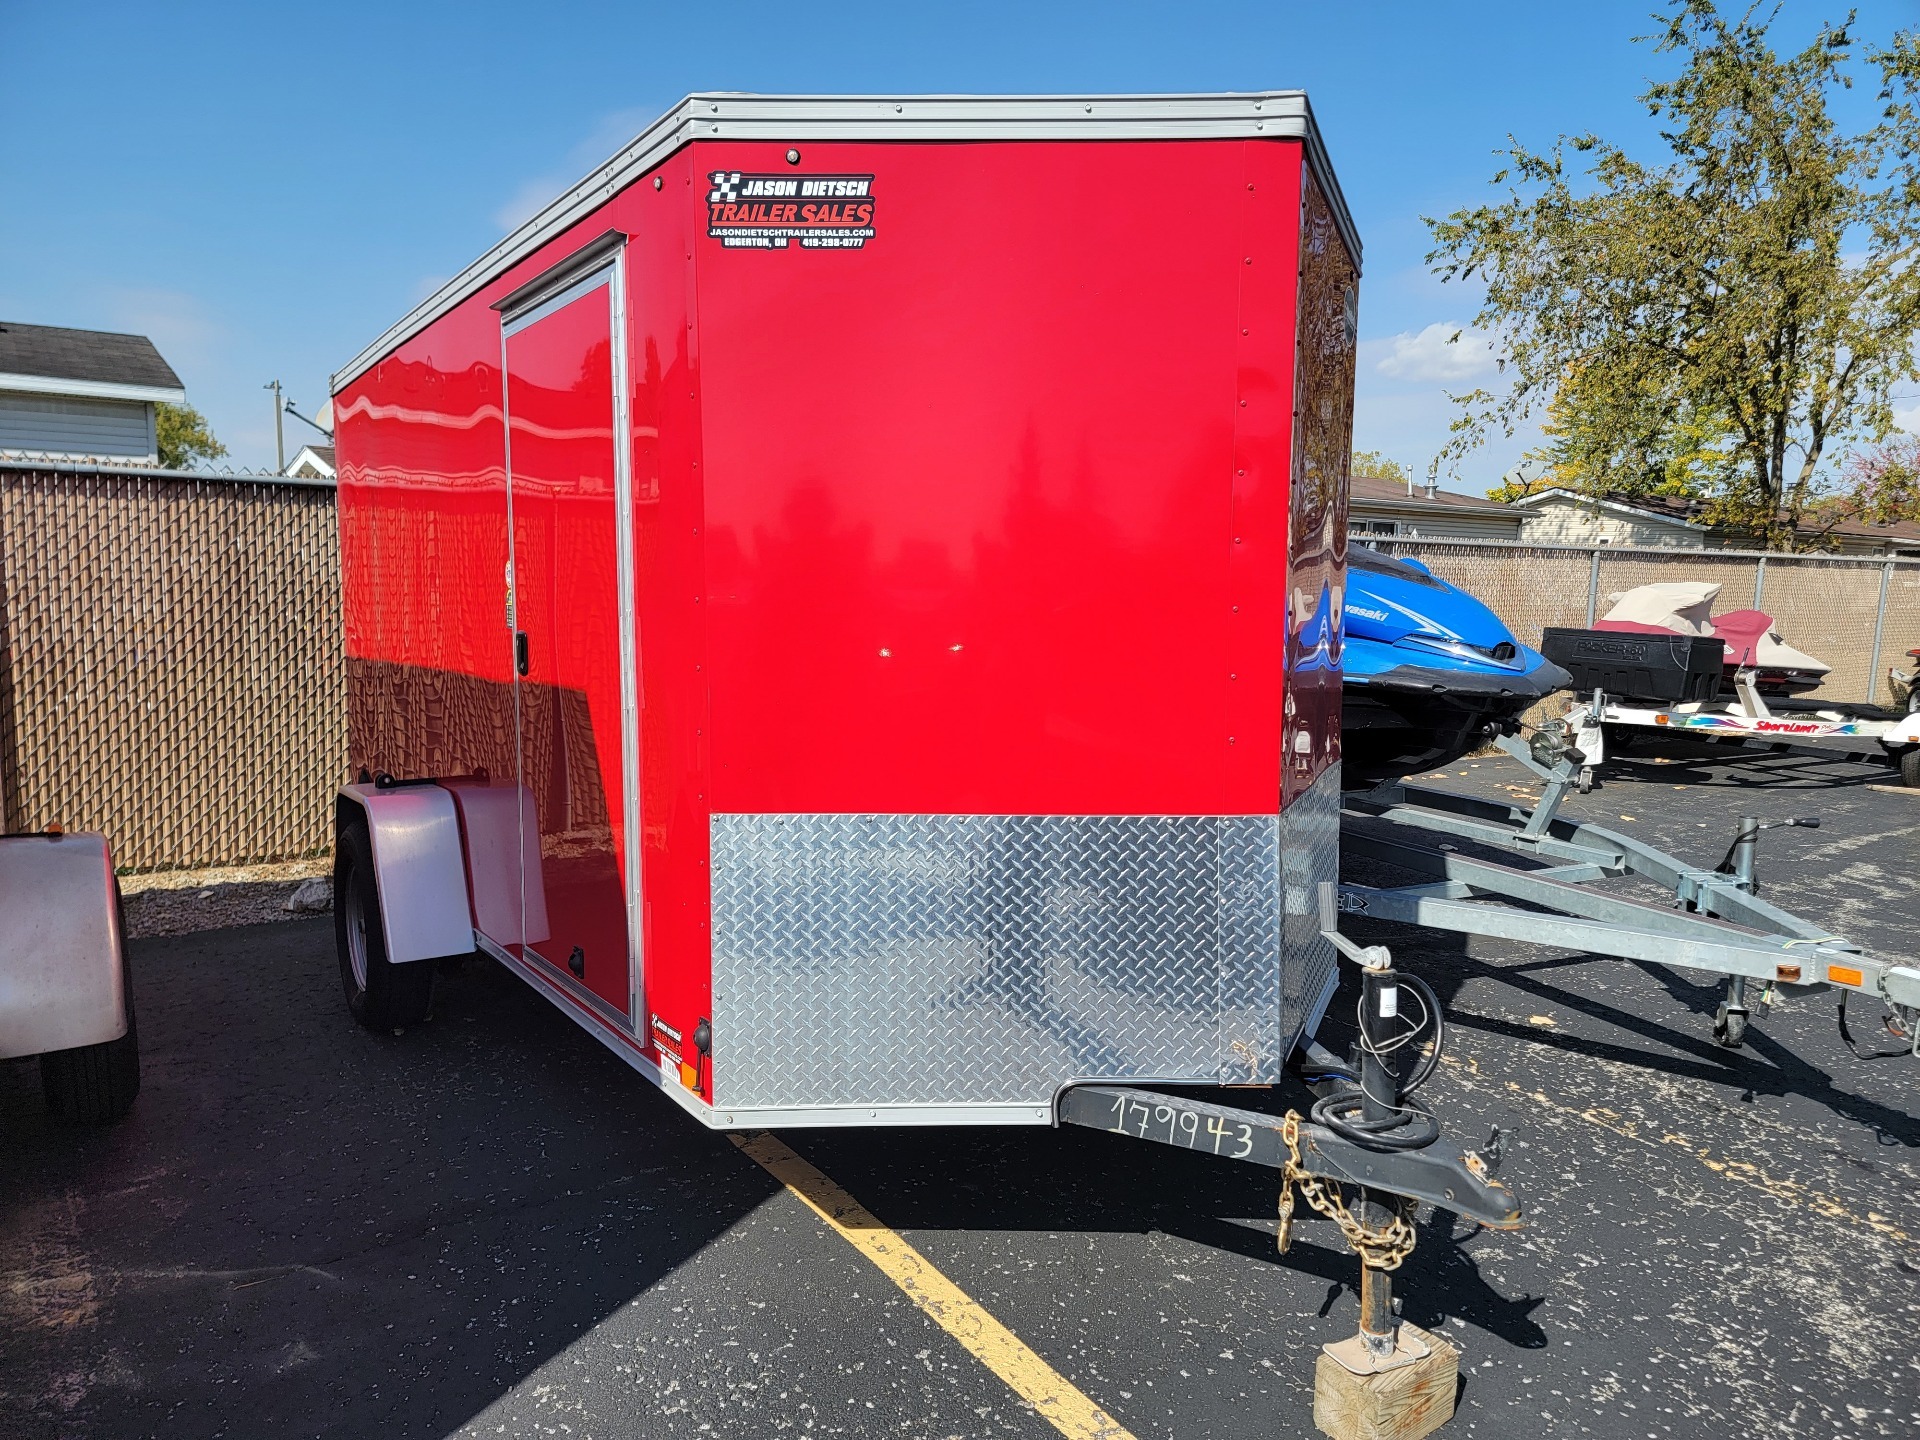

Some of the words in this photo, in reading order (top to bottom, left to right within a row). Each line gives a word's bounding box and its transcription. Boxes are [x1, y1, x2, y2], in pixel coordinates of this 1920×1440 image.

[742, 181, 798, 196] JASON
[801, 181, 869, 196] DIETSCH
[711, 203, 798, 222] TRAILER
[801, 203, 873, 224] SALES
[710, 228, 873, 237] JASONDIETSCHTRAILERSALES.COM
[724, 238, 772, 248] EDGERTON,
[774, 238, 787, 247] OH
[802, 237, 864, 247] 419-298-0777
[1109, 1095, 1253, 1158] 179943
